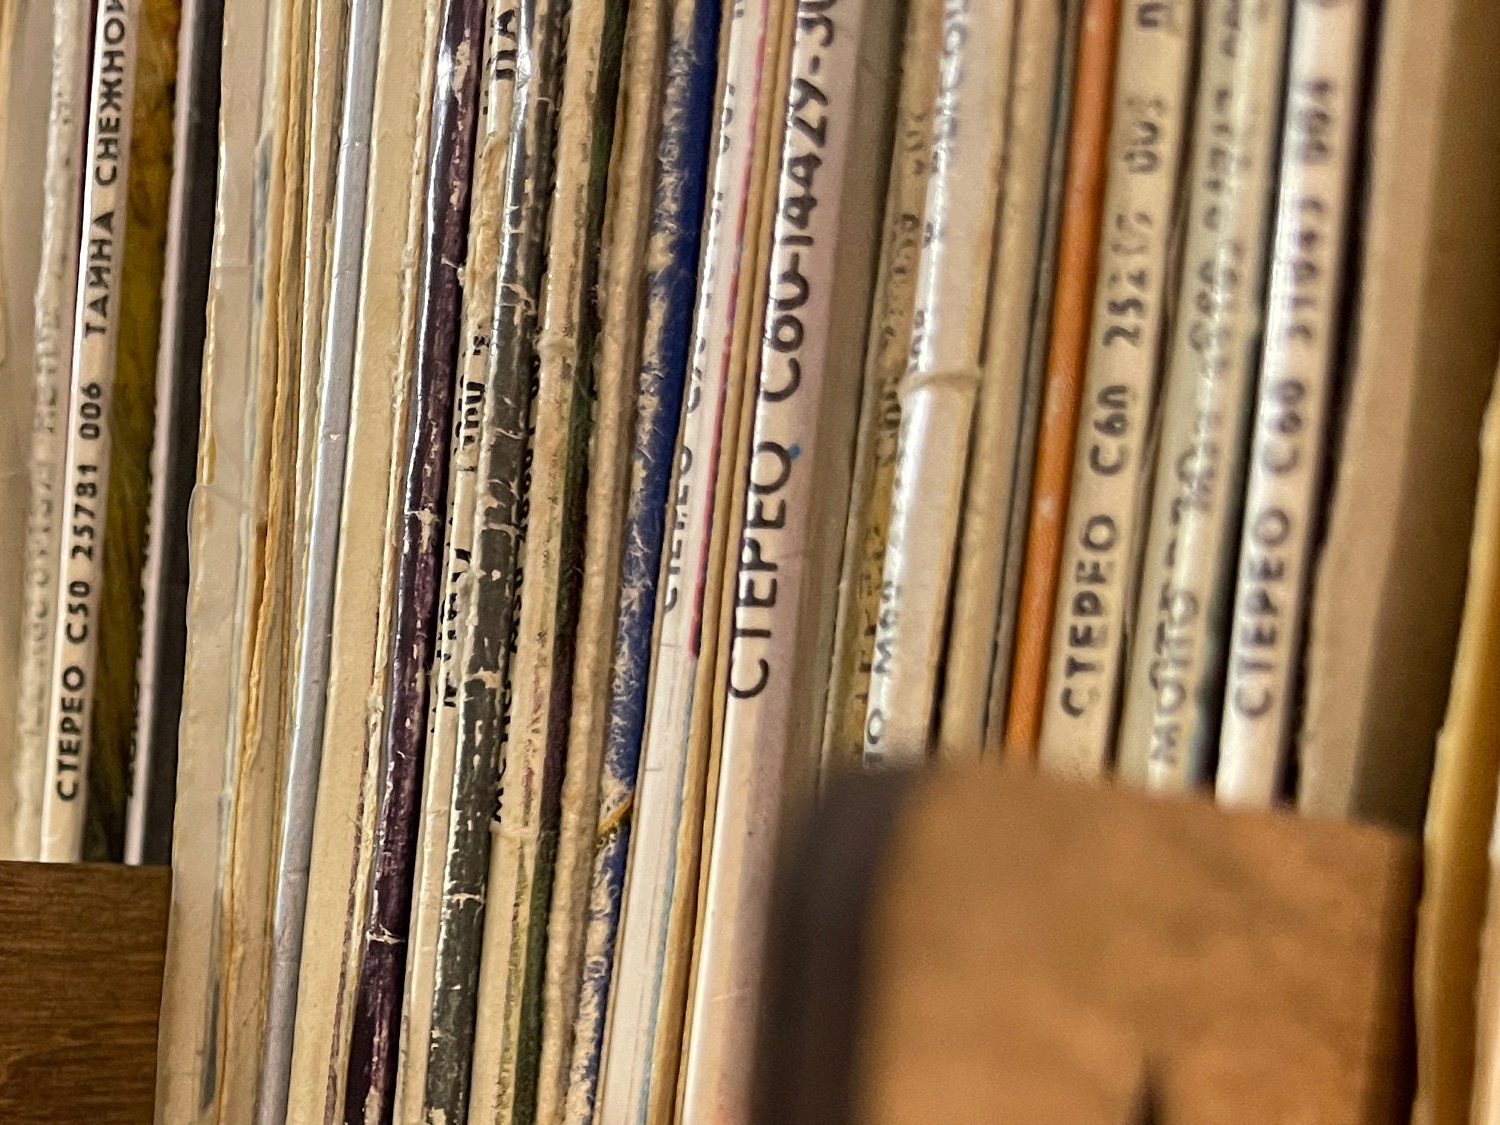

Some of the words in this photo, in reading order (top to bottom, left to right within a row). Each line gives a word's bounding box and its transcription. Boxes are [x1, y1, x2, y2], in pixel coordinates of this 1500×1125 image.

[79, 381, 103, 440] 006
[71, 463, 99, 561] 25781
[729, 440, 794, 699] СТЕРЕО
[66, 580, 91, 644] С50
[1060, 513, 1120, 718] СТЕРЕО
[1234, 506, 1293, 720] СТЕРЕО
[56, 665, 86, 802] СТЕРЕО
